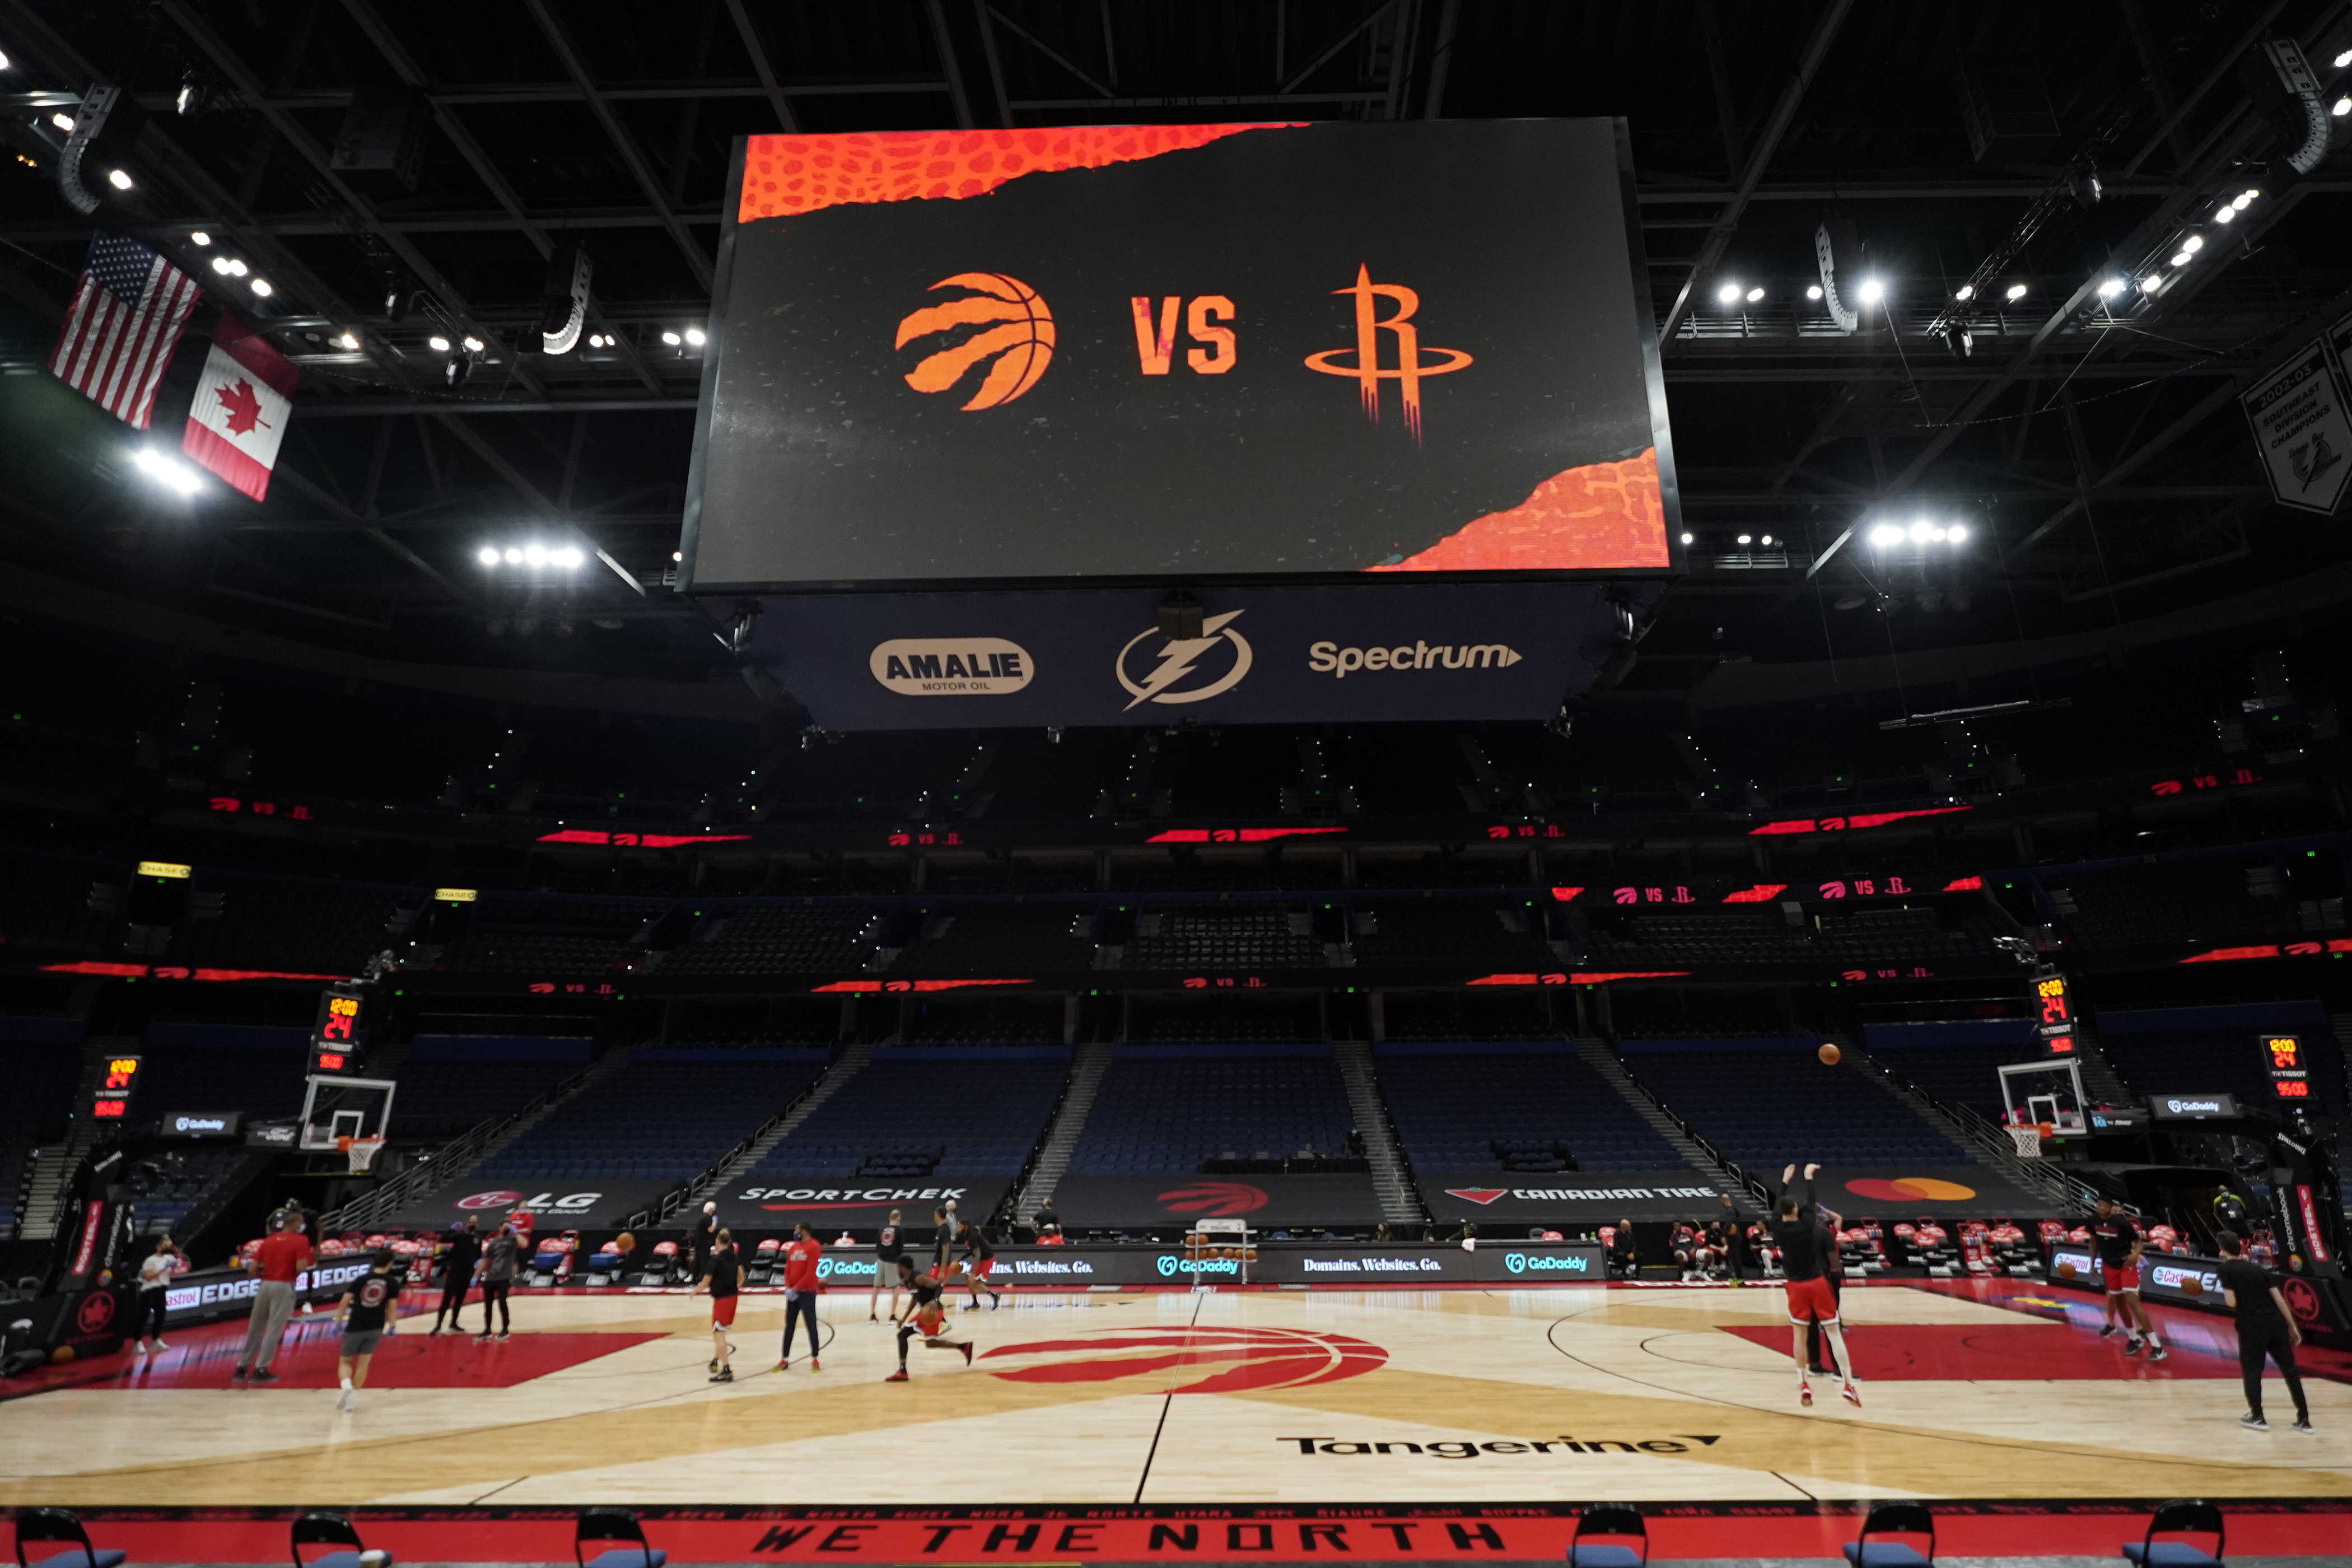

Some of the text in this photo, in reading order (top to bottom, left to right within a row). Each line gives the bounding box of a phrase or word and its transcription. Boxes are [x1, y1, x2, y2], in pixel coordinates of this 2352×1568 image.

[1131, 295, 1236, 375] VS
[2259, 363, 2311, 408] 2002-03
[2263, 381, 2320, 427] SOUTHEAST
[2271, 404, 2330, 449] CHAMPIONS
[2275, 399, 2317, 433] DIVISION
[886, 653, 1023, 680] AMALIE
[1309, 640, 1509, 678] Spectrum
[922, 682, 990, 691] MOTOR OIL
[138, 865, 178, 874] CHASE
[1645, 888, 1663, 903] VS
[1854, 880, 1874, 895] VS
[2041, 997, 2067, 1023] 24
[324, 1012, 353, 1039] 24
[2274, 1052, 2296, 1068] 24
[2181, 1102, 2219, 1113] GoDaddy
[2277, 1132, 2307, 1155] SPALDING
[528, 1192, 602, 1208] LG
[738, 1188, 967, 1200] SPORTCHEK
[1513, 1187, 1718, 1200] CANADIAN TIRE
[2276, 1186, 2296, 1252] chromebook
[2304, 1204, 2324, 1258] BIOSTEEL
[320, 1264, 371, 1287] EDGE
[834, 1261, 878, 1275] GoDad
[1014, 1260, 1072, 1274] Websites.
[1072, 1260, 1094, 1274] Go.
[1304, 1258, 1441, 1272] Domains. Websites. Go.
[1527, 1256, 1588, 1272] GoDaddy
[166, 1290, 196, 1306] astrol
[1277, 1436, 1690, 1459] Tangerine
[753, 1523, 1505, 1552] WE THE NORTH
